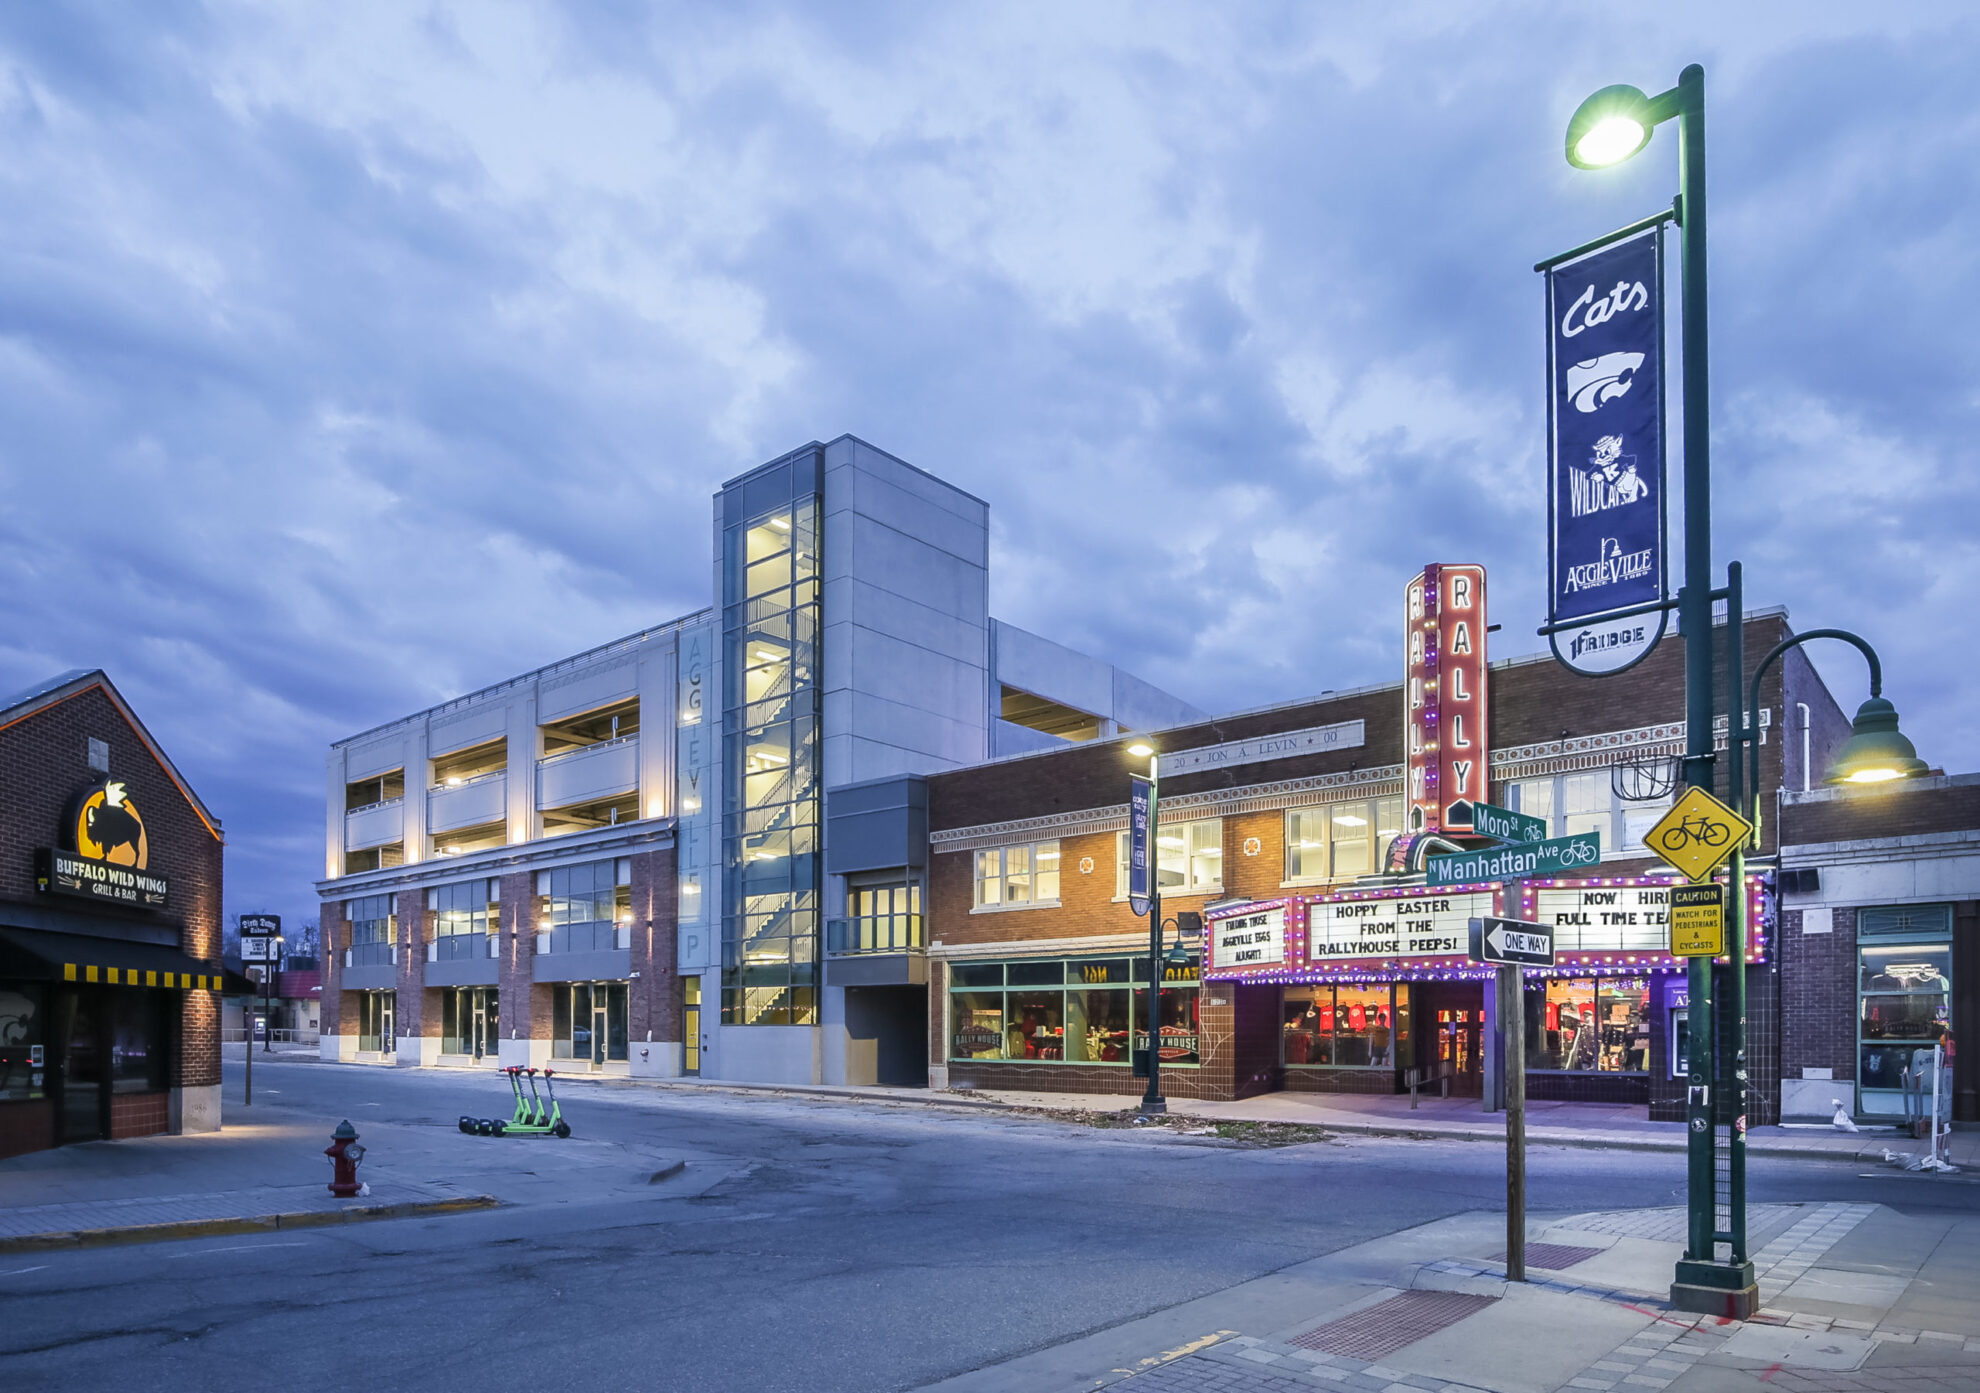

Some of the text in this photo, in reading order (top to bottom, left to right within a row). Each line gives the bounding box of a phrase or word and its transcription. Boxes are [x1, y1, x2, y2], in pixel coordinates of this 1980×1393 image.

[1562, 281, 1648, 338] Cats
[1569, 466, 1630, 517] WILDCA
[1564, 550, 1652, 593] AGGIEVILLE
[1410, 586, 1424, 800] RALLY
[1451, 575, 1472, 795] RALLY
[1174, 731, 1338, 768] 20 JON A. LEVIN 00
[1477, 807, 1519, 837] Moro St
[1429, 845, 1559, 881] N Manhattan Ave
[56, 857, 167, 894] BUFFALO WILD WINGS
[92, 883, 137, 901] GRILL & BAR
[1583, 892, 1617, 905] NOW
[1675, 891, 1717, 902] CAUTION
[1336, 900, 1450, 918] HOPPY EASTER
[1703, 909, 1717, 917] FOR
[1249, 915, 1267, 928] THOSE
[1360, 920, 1433, 935] FROM THE
[1556, 912, 1591, 926] FULL
[1600, 912, 1637, 925] TIME
[1675, 920, 1718, 929] PEDESTRIANS
[1255, 931, 1271, 943] EGGS
[1505, 932, 1547, 952] ONE WAY
[688, 935, 699, 959] P
[1319, 938, 1457, 955] RALLYHOUSE PEEPS!
[1139, 1037, 1197, 1050] RAY HOUSE
